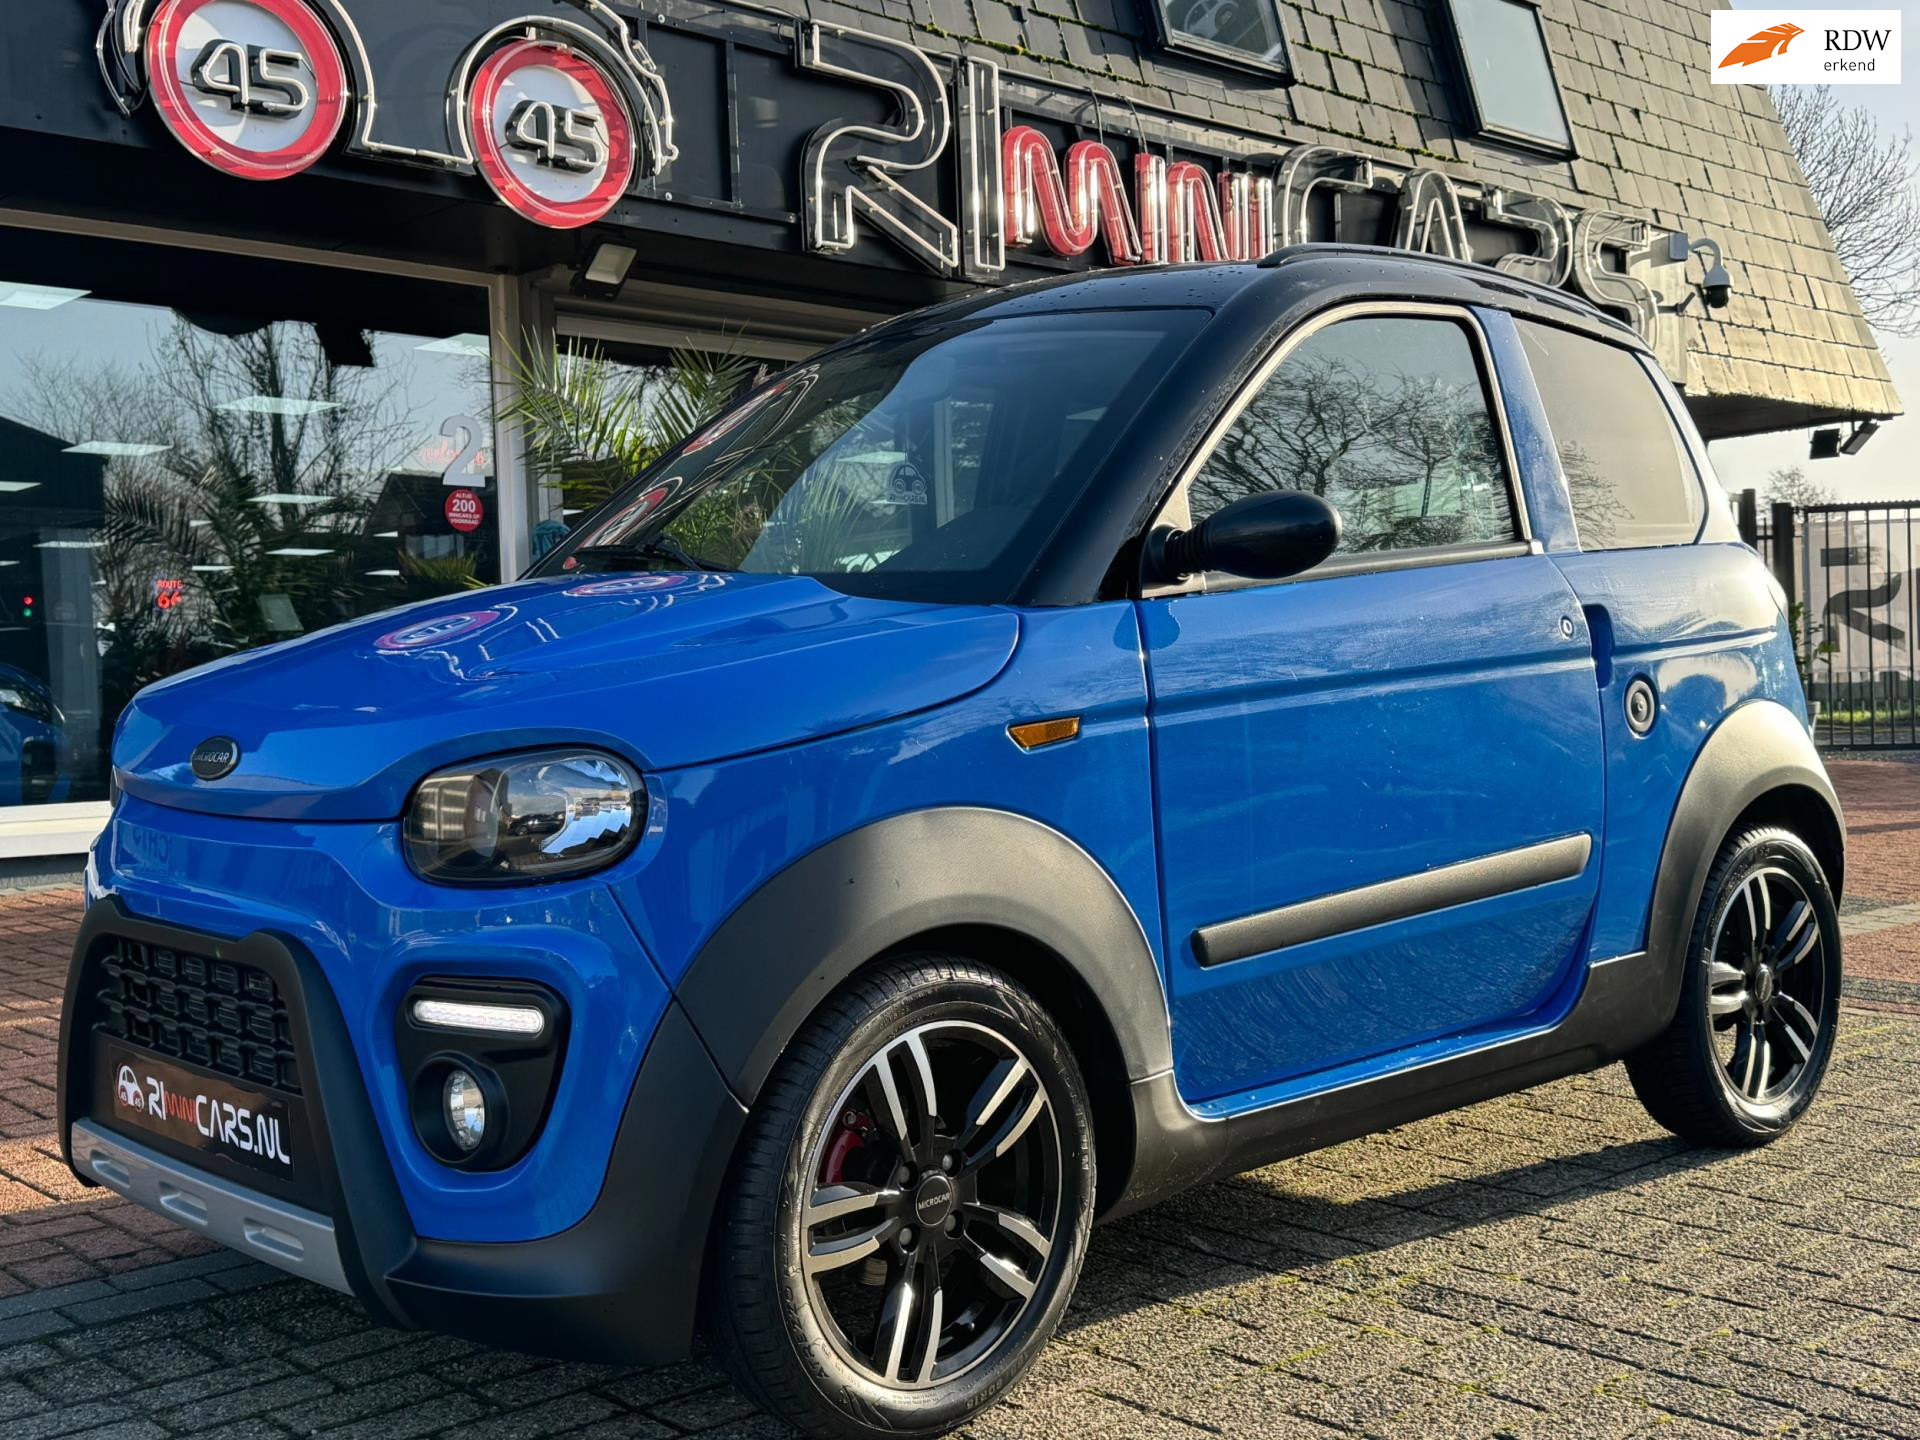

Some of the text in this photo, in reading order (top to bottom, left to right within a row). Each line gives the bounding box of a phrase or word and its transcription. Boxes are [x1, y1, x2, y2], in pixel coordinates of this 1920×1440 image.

[190, 38, 309, 120] 45
[505, 98, 604, 174] 45
[440, 415, 486, 488] 2
[452, 499, 476, 512] 200
[918, 1192, 951, 1210] MICROCAR
